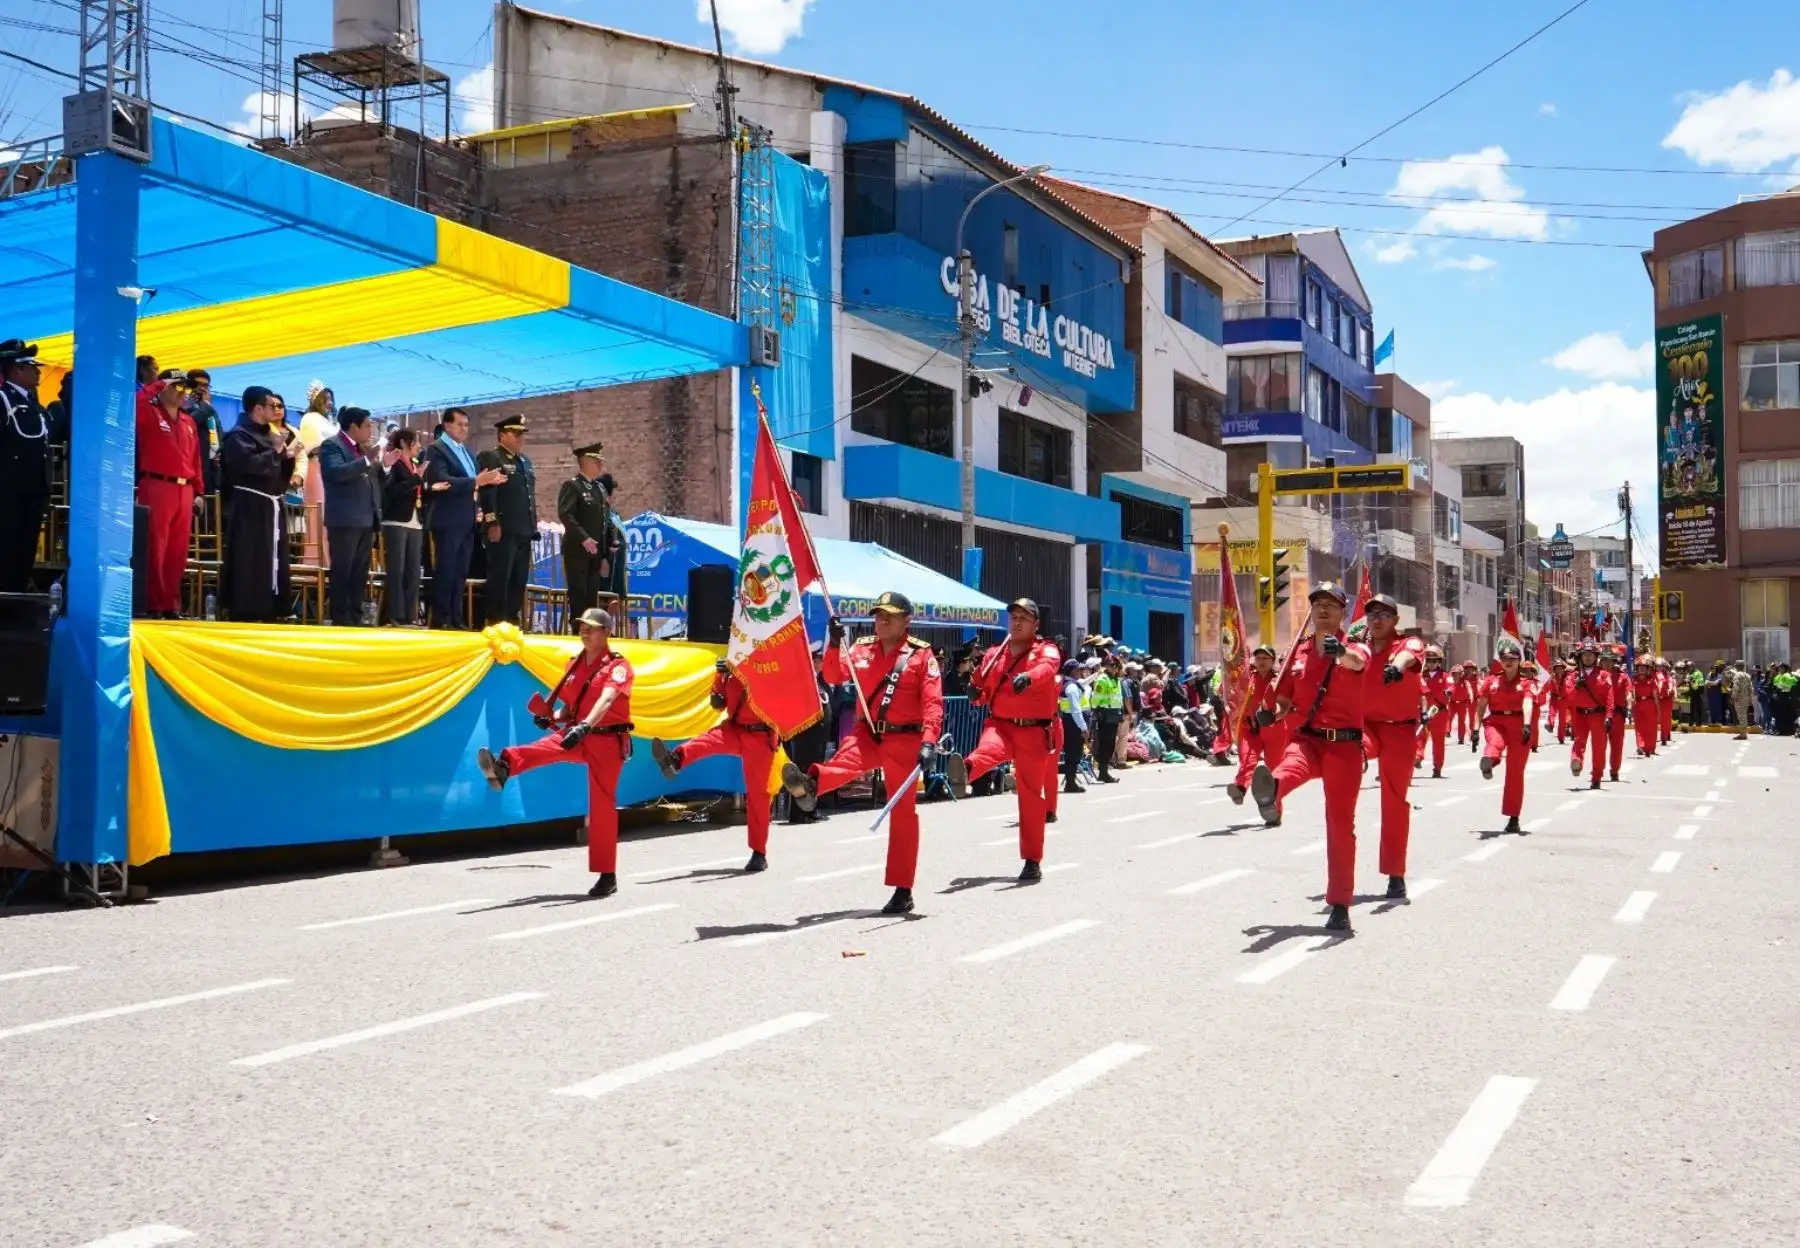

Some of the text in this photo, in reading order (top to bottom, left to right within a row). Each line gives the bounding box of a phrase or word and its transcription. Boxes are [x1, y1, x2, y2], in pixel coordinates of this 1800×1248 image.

[997, 282, 1021, 326] DE
[1025, 299, 1050, 340] LA
[1053, 314, 1116, 370] CULTURA
[1063, 350, 1097, 379] INTERNET
[1667, 350, 1709, 382] 100
[932, 603, 999, 625] CENTENARIO
